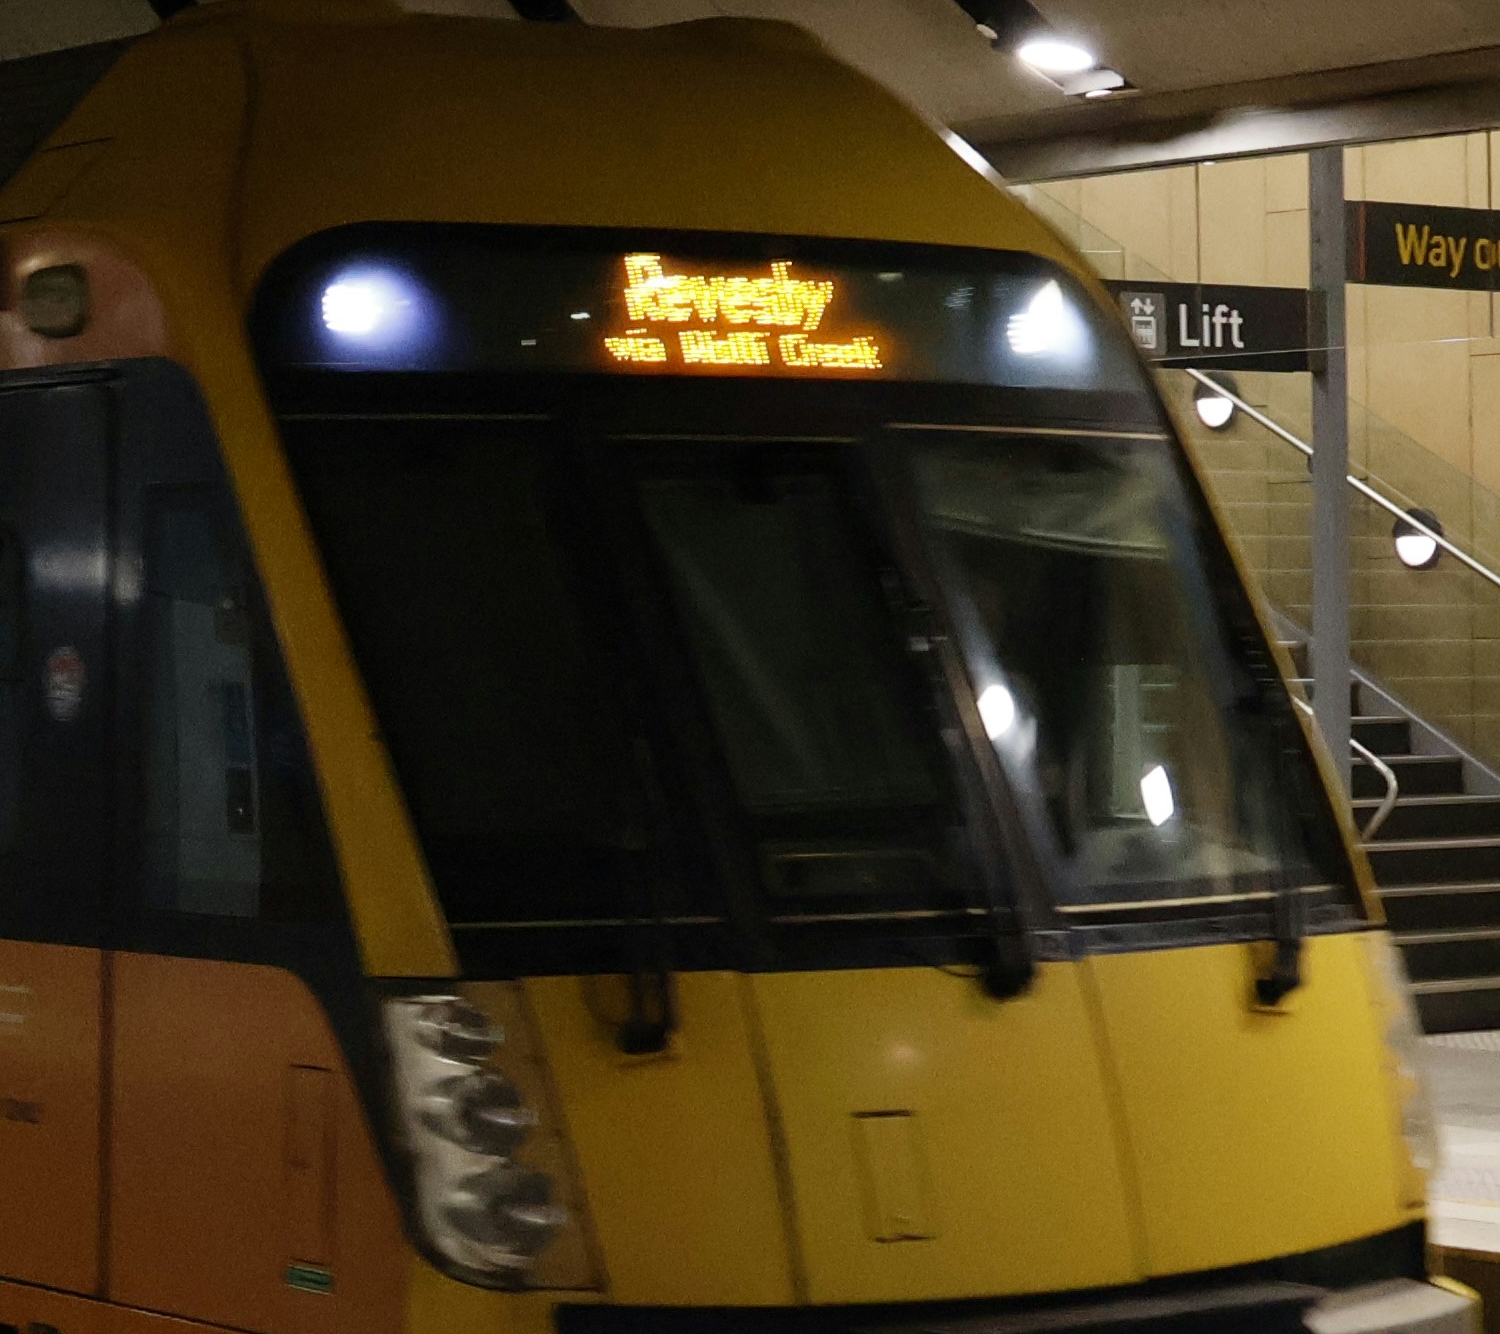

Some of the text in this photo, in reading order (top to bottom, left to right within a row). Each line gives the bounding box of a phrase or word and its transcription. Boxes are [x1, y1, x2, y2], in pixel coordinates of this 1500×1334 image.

[1395, 221, 1467, 278] Way
[623, 252, 834, 331] Revesby
[1177, 302, 1245, 349] Lift
